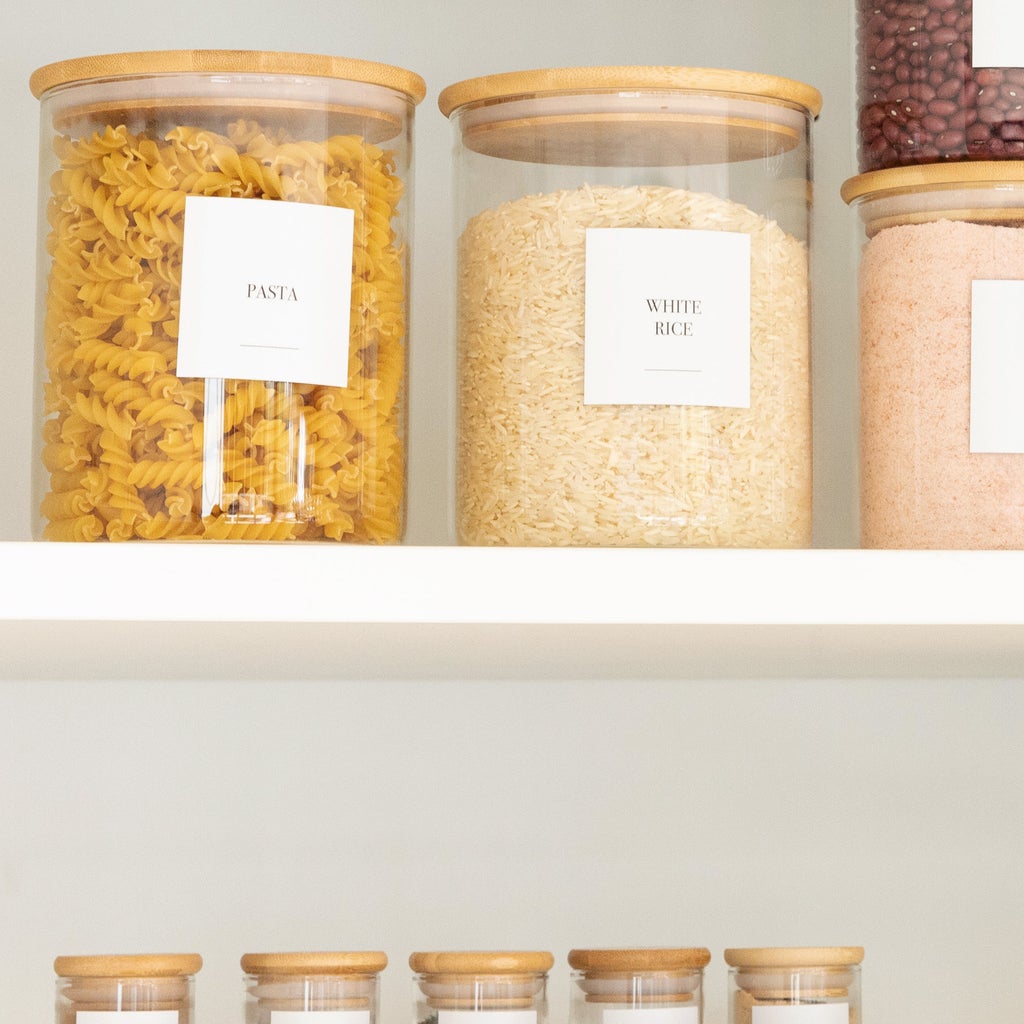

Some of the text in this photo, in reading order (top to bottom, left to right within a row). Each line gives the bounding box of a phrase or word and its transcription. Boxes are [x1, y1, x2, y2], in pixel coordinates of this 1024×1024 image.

[247, 283, 298, 302] PASTA
[646, 298, 702, 314] WHITE
[655, 321, 693, 337] RICE
